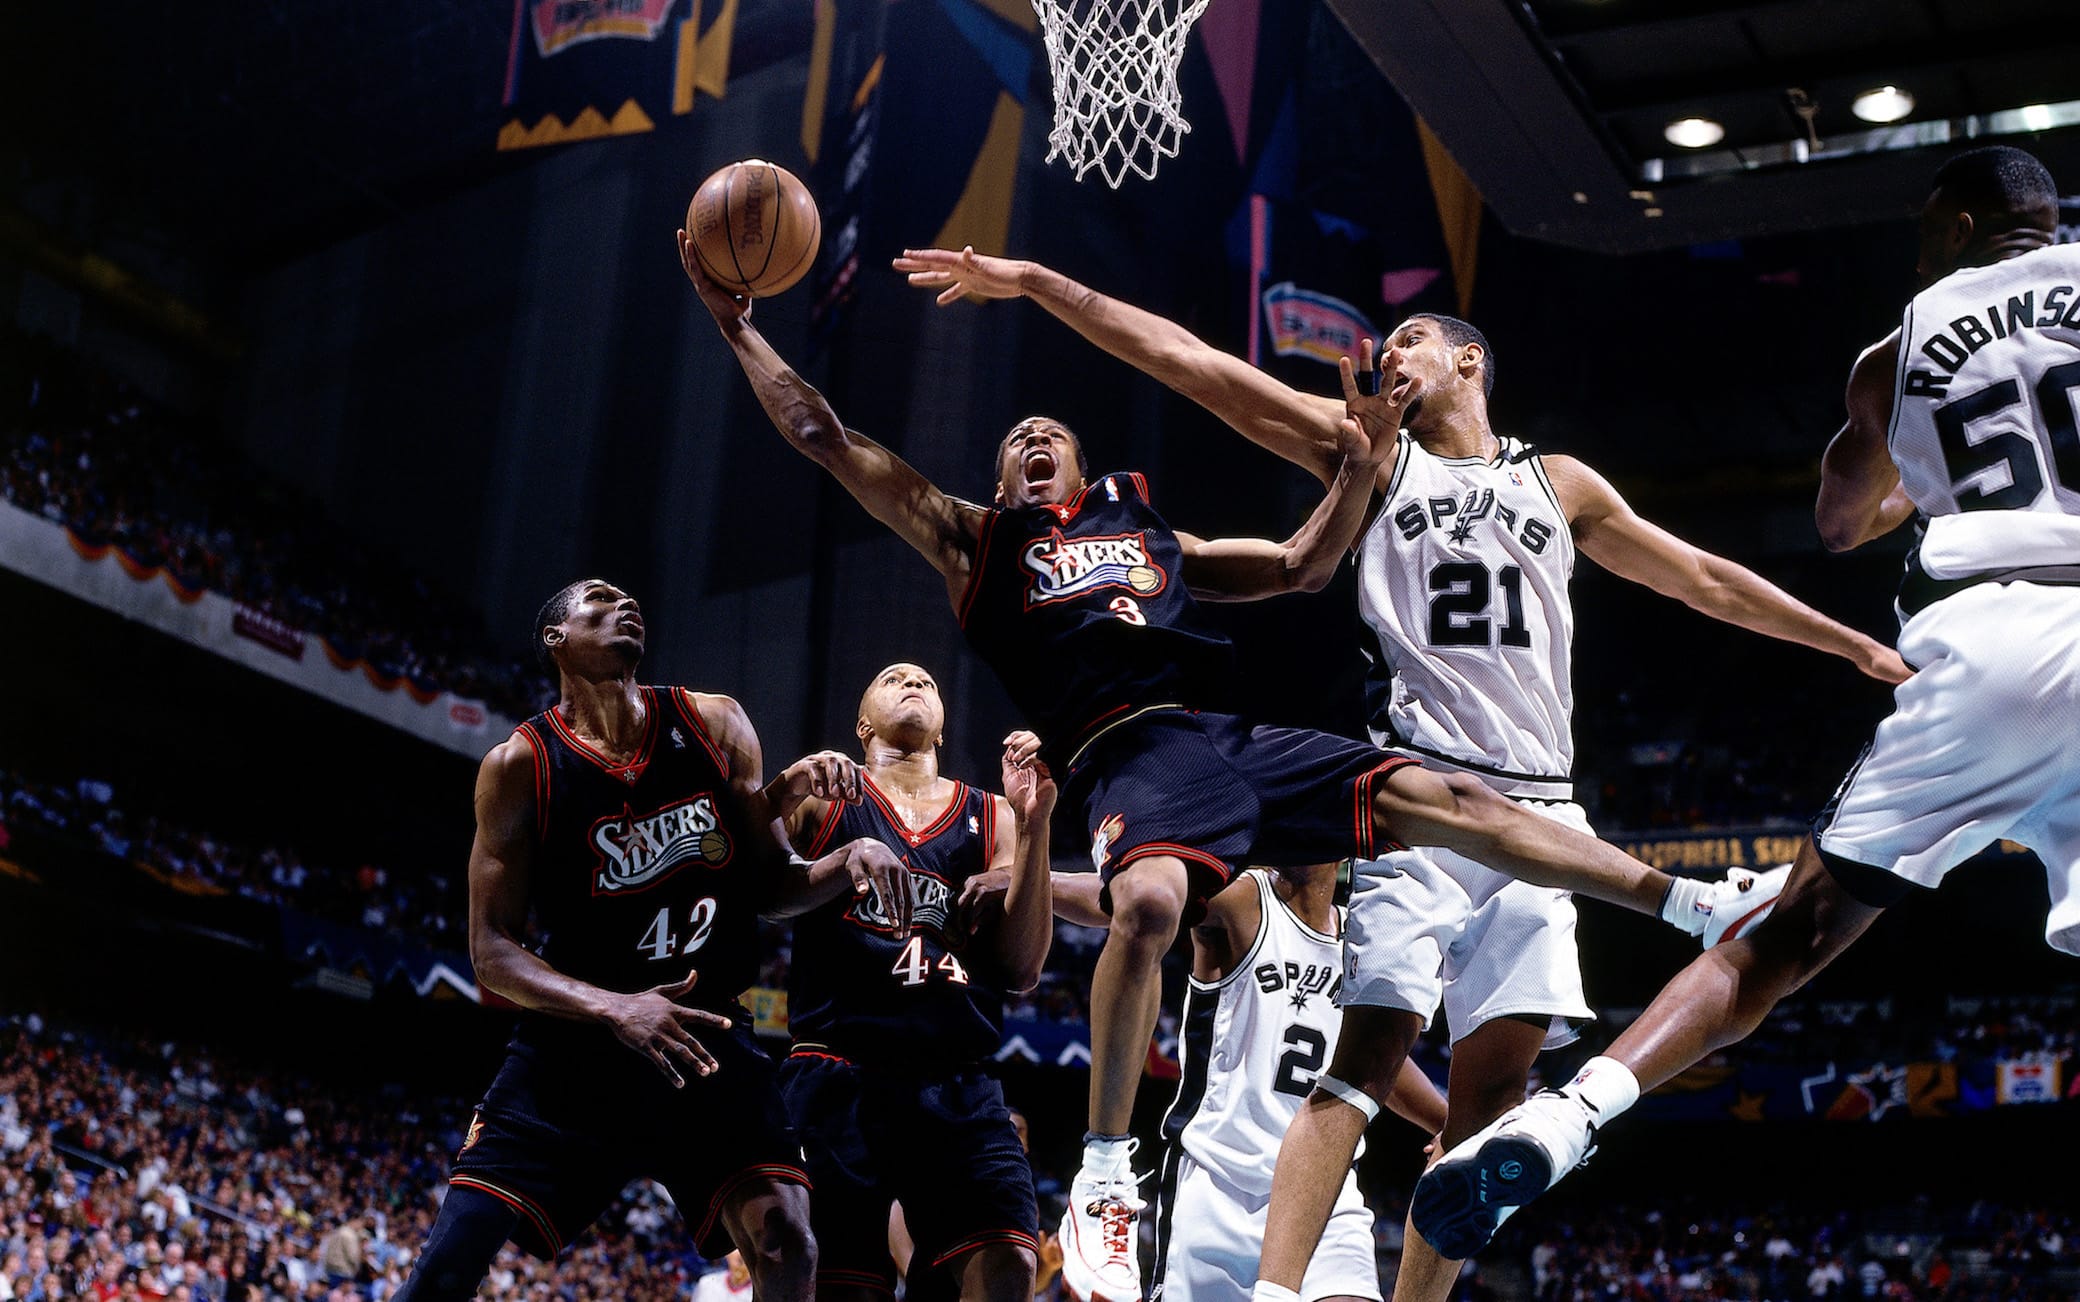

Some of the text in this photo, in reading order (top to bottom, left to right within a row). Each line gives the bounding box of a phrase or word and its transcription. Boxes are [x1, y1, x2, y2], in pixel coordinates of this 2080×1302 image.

[1904, 286, 2080, 398] ROBINS
[1394, 488, 1557, 555] SPURS
[1025, 538, 1148, 604] SIXERS
[1428, 560, 1532, 648] 21
[1108, 596, 1148, 627] 3
[596, 798, 716, 890] SIXERS
[636, 896, 718, 961] 42
[891, 935, 970, 986] 44
[1254, 961, 1343, 1016] SPU
[1272, 1022, 1328, 1099] 2
